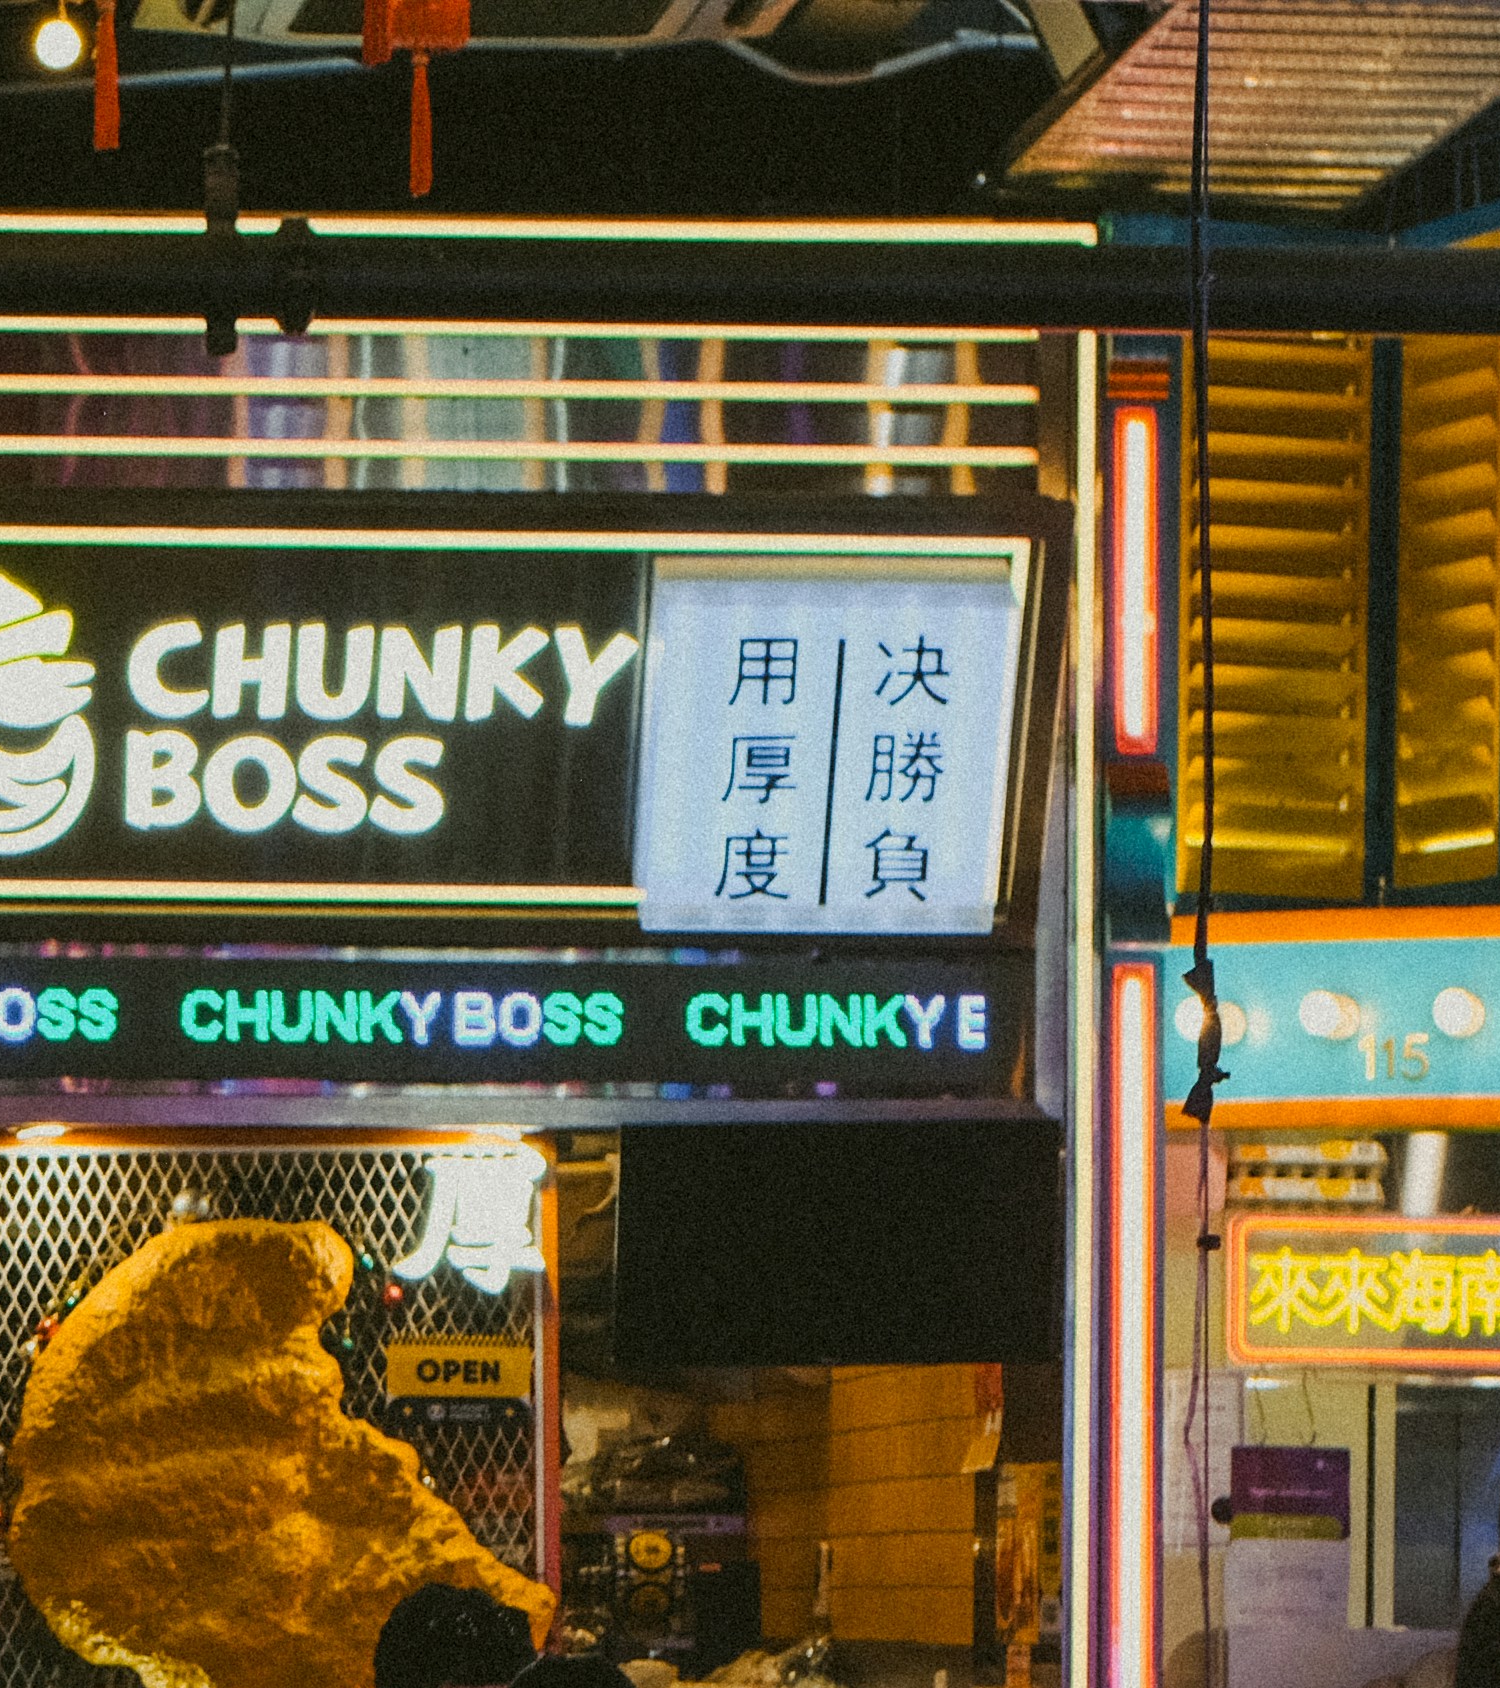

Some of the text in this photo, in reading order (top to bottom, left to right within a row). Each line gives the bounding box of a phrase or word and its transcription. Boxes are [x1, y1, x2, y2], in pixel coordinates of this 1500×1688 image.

[126, 620, 640, 727] CHUNKY
[124, 729, 445, 834] BOSS
[713, 636, 799, 900] 用厚度
[179, 988, 444, 1047] CHUNKY
[451, 990, 625, 1049] BOSS
[684, 992, 944, 1052] CHUNKY
[1357, 1032, 1431, 1082] 115
[416, 1358, 501, 1385] OPEN
